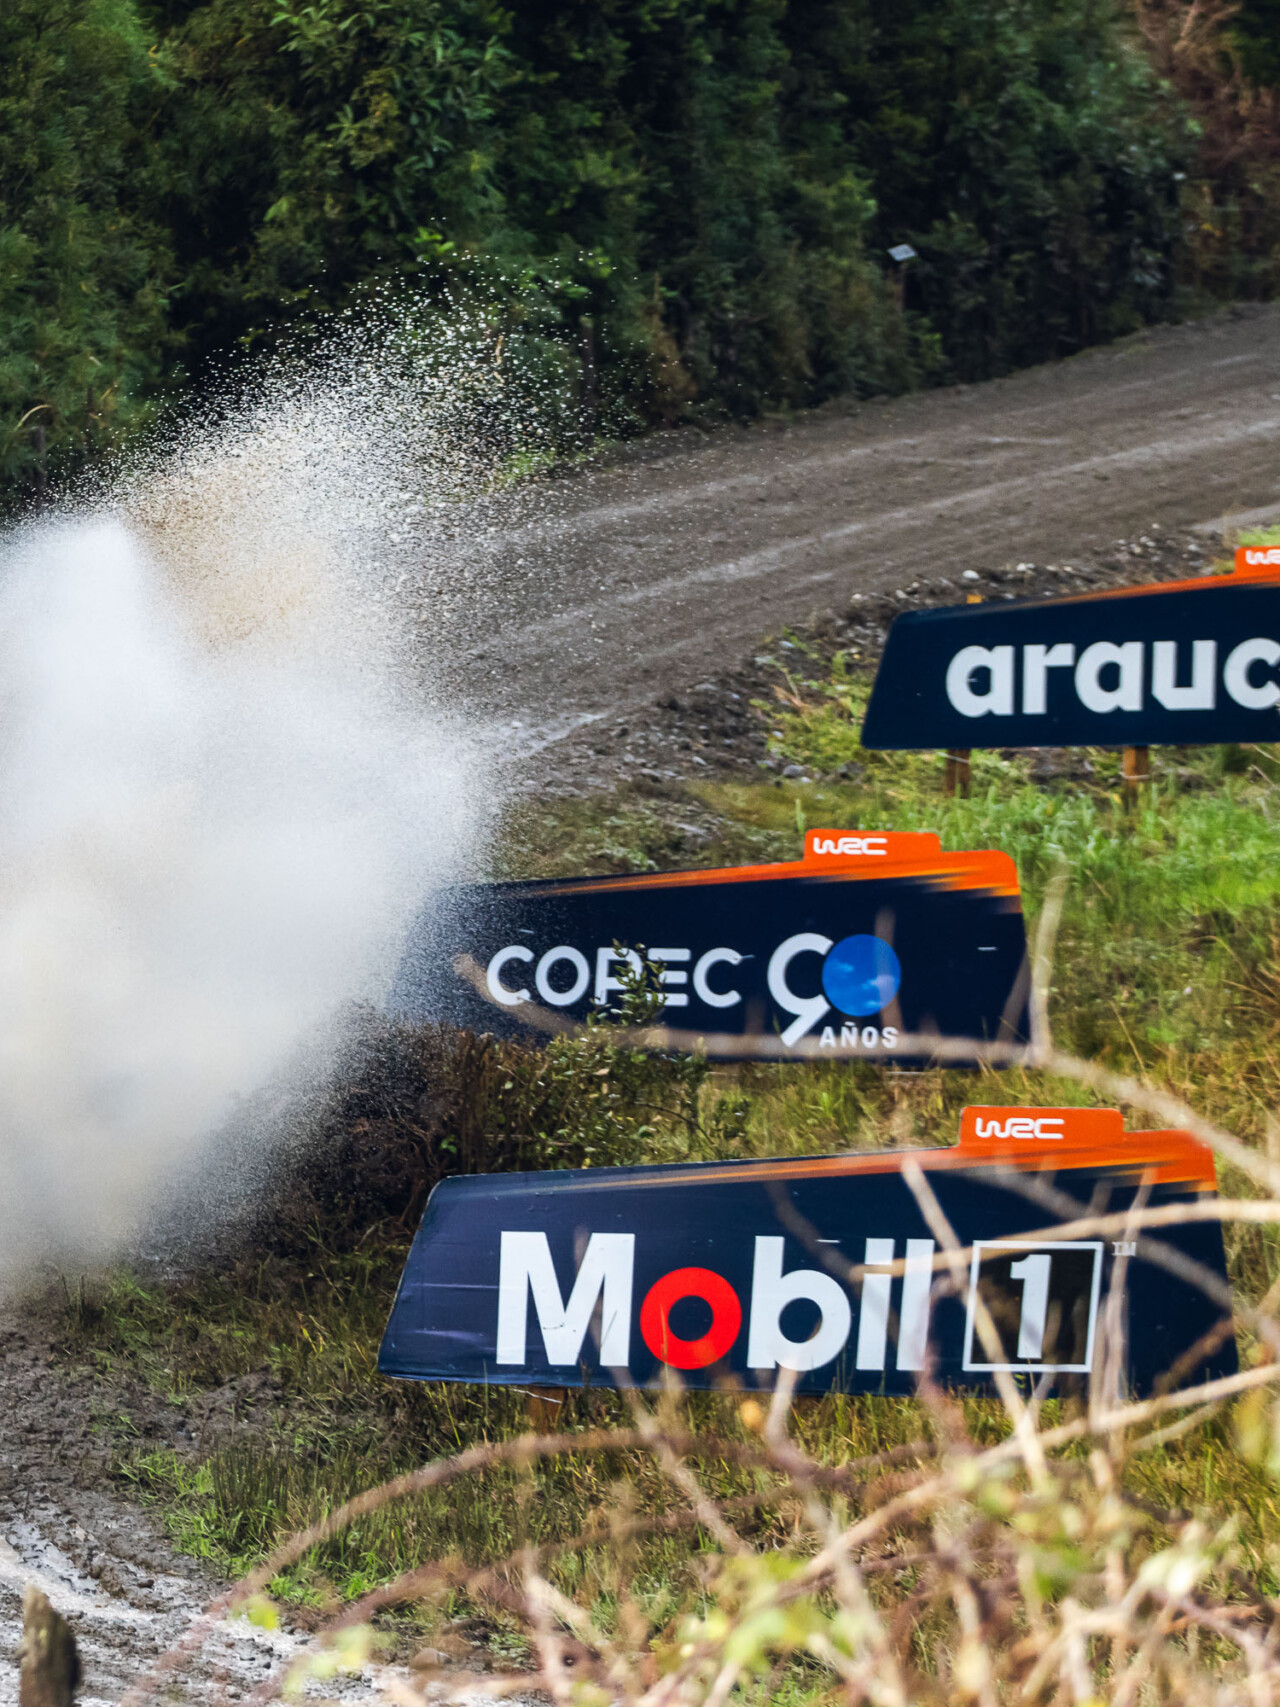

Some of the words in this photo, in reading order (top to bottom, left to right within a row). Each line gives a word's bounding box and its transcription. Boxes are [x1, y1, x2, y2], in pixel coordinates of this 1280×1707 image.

[813, 837, 887, 856] WRC
[487, 945, 742, 1008] COPEC
[820, 1022, 899, 1049] AÑOS
[975, 1116, 1065, 1140] WRC
[496, 1231, 935, 1372] Mobil
